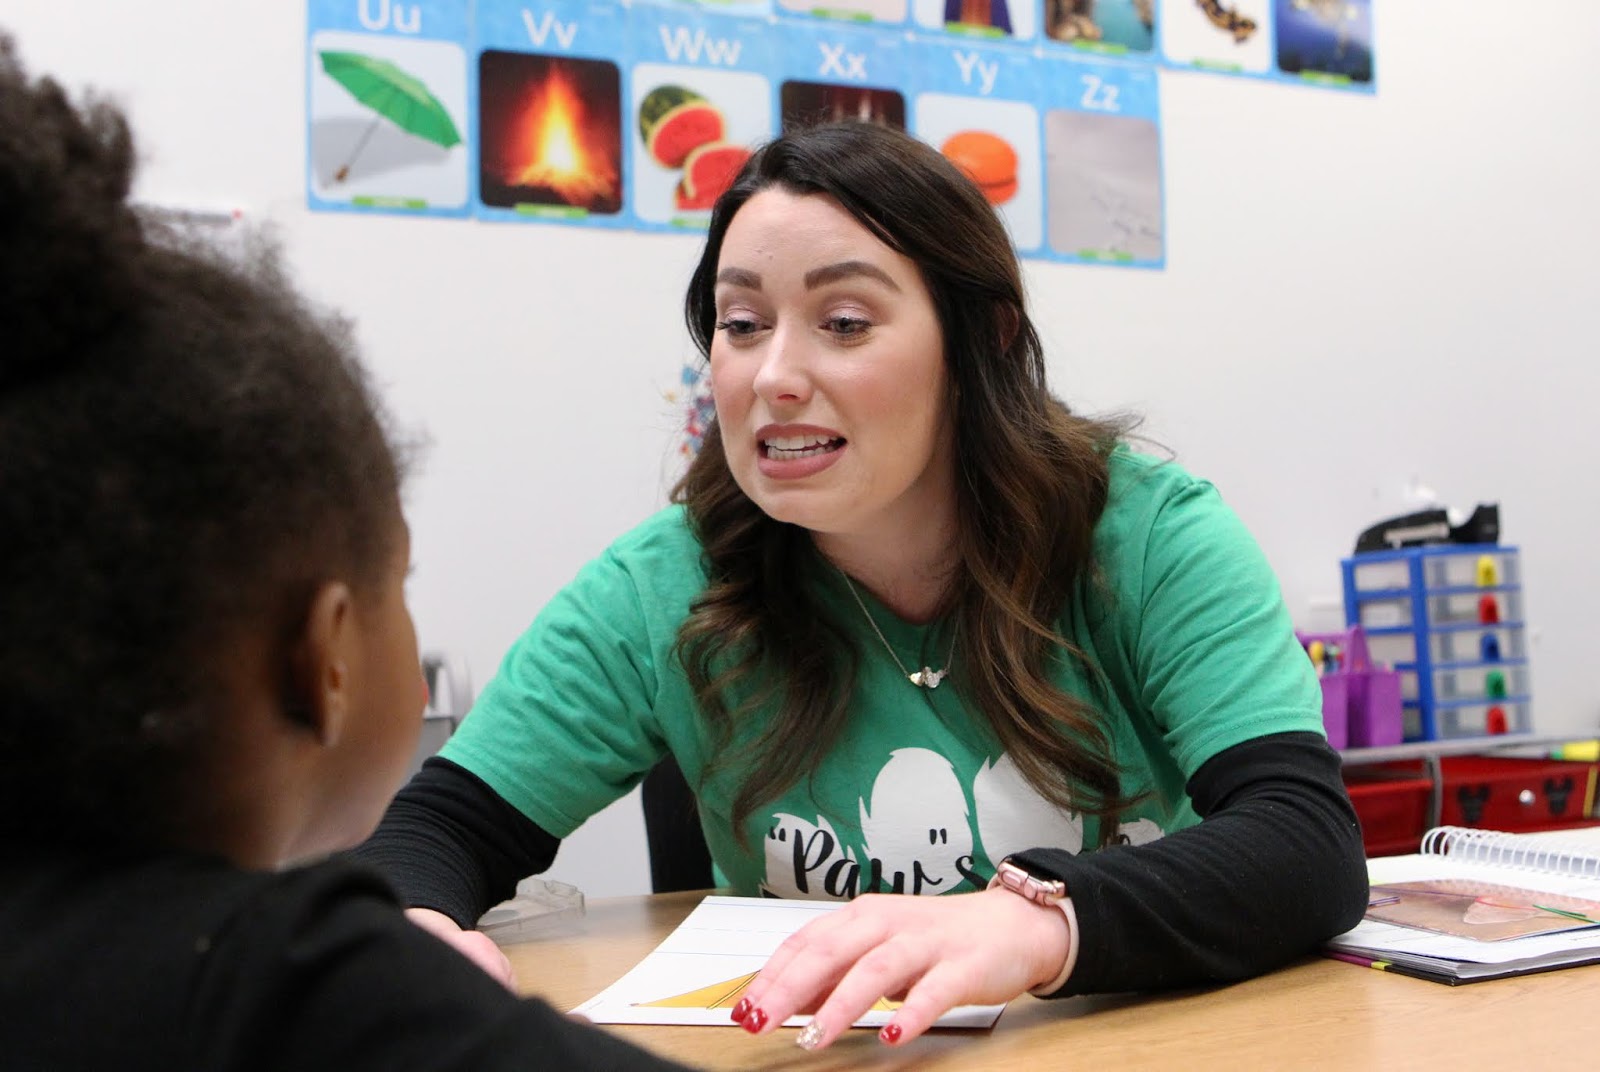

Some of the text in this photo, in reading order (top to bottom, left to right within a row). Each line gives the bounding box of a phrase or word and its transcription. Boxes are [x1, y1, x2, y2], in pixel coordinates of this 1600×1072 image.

[522, 7, 578, 48] Vv
[660, 24, 742, 65] Ww
[818, 42, 867, 80] Xx
[952, 49, 999, 95] Yy
[1080, 74, 1120, 111] Zz
